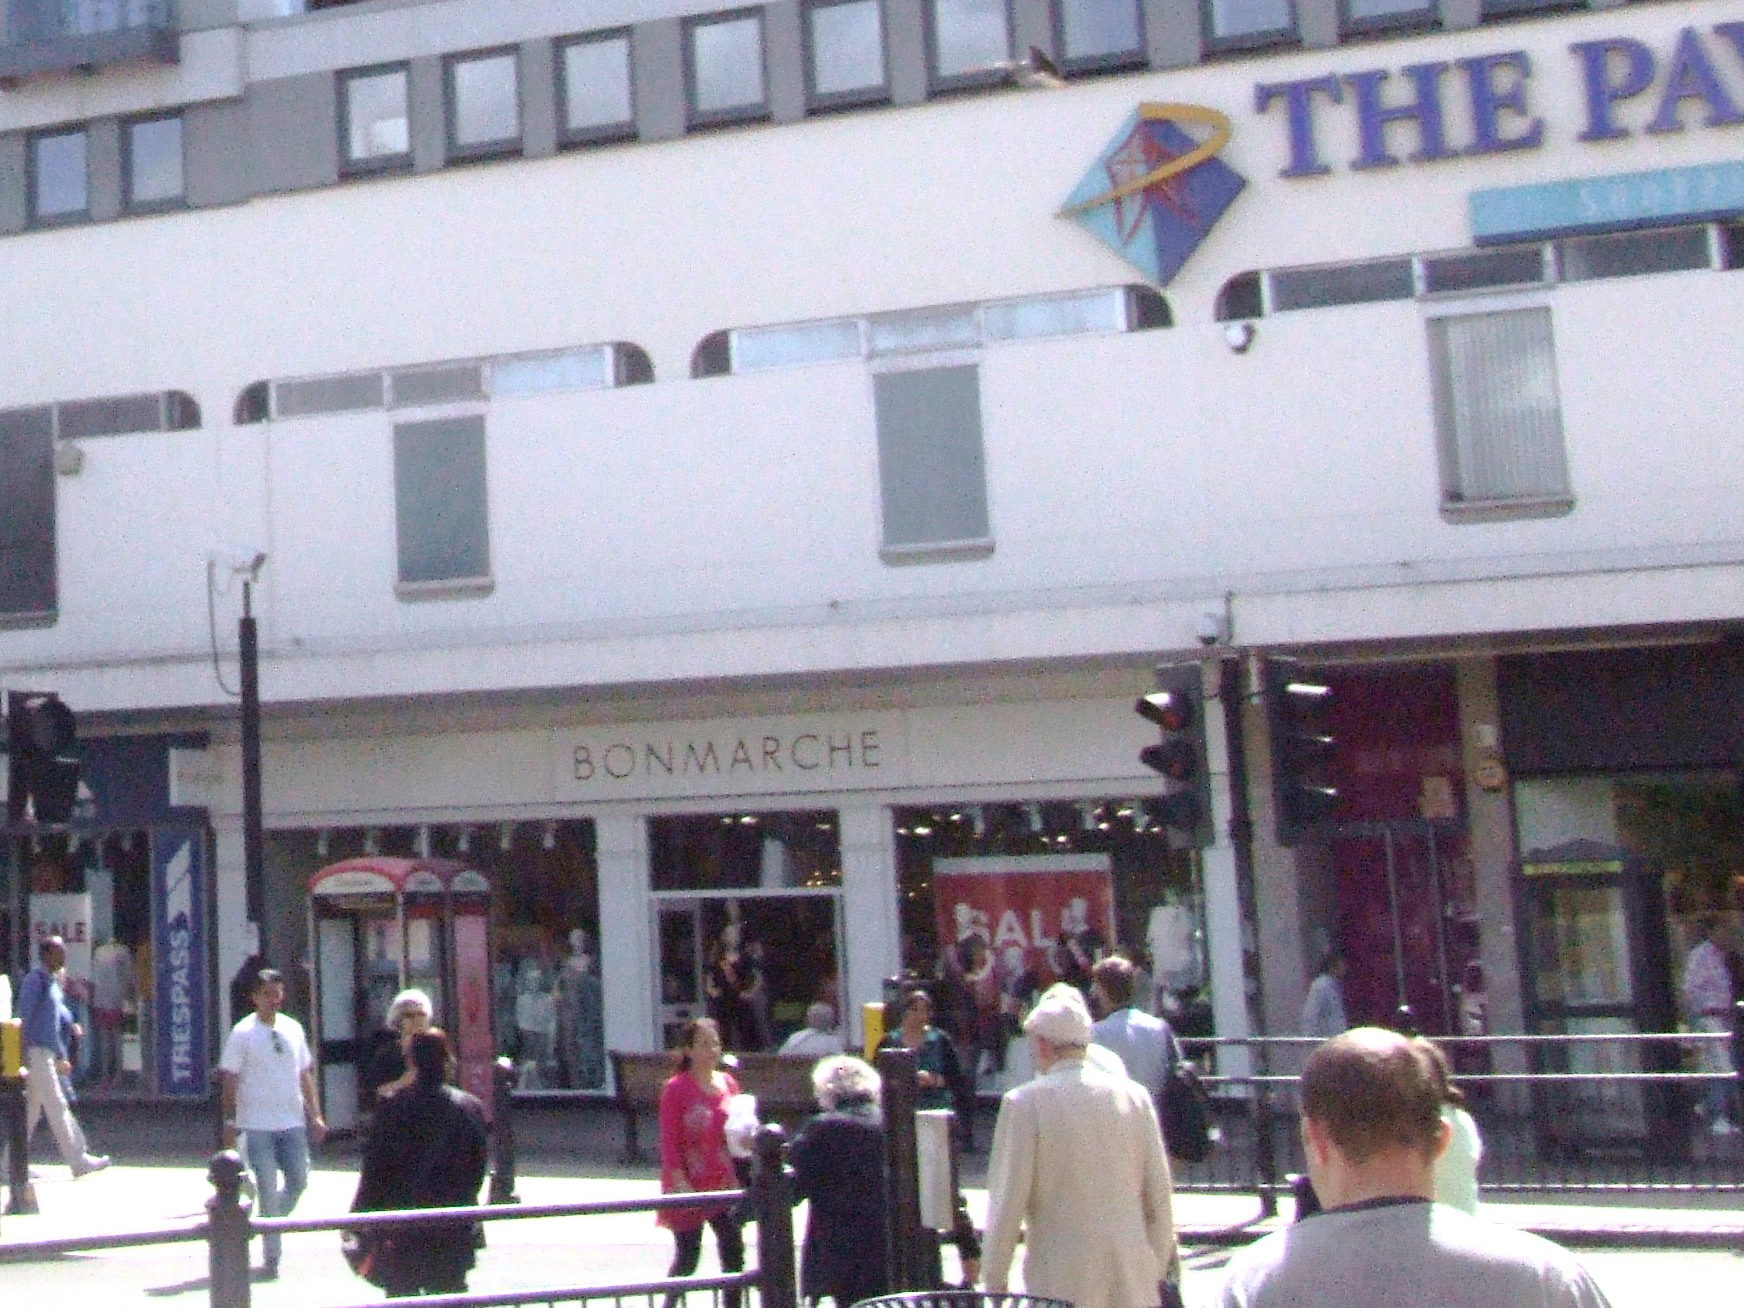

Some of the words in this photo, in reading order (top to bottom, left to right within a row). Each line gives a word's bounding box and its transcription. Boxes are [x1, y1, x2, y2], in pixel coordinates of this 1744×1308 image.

[1254, 49, 1546, 180] THE
[572, 729, 882, 783] BONMARCHE
[169, 928, 192, 1082] TRESPASS
